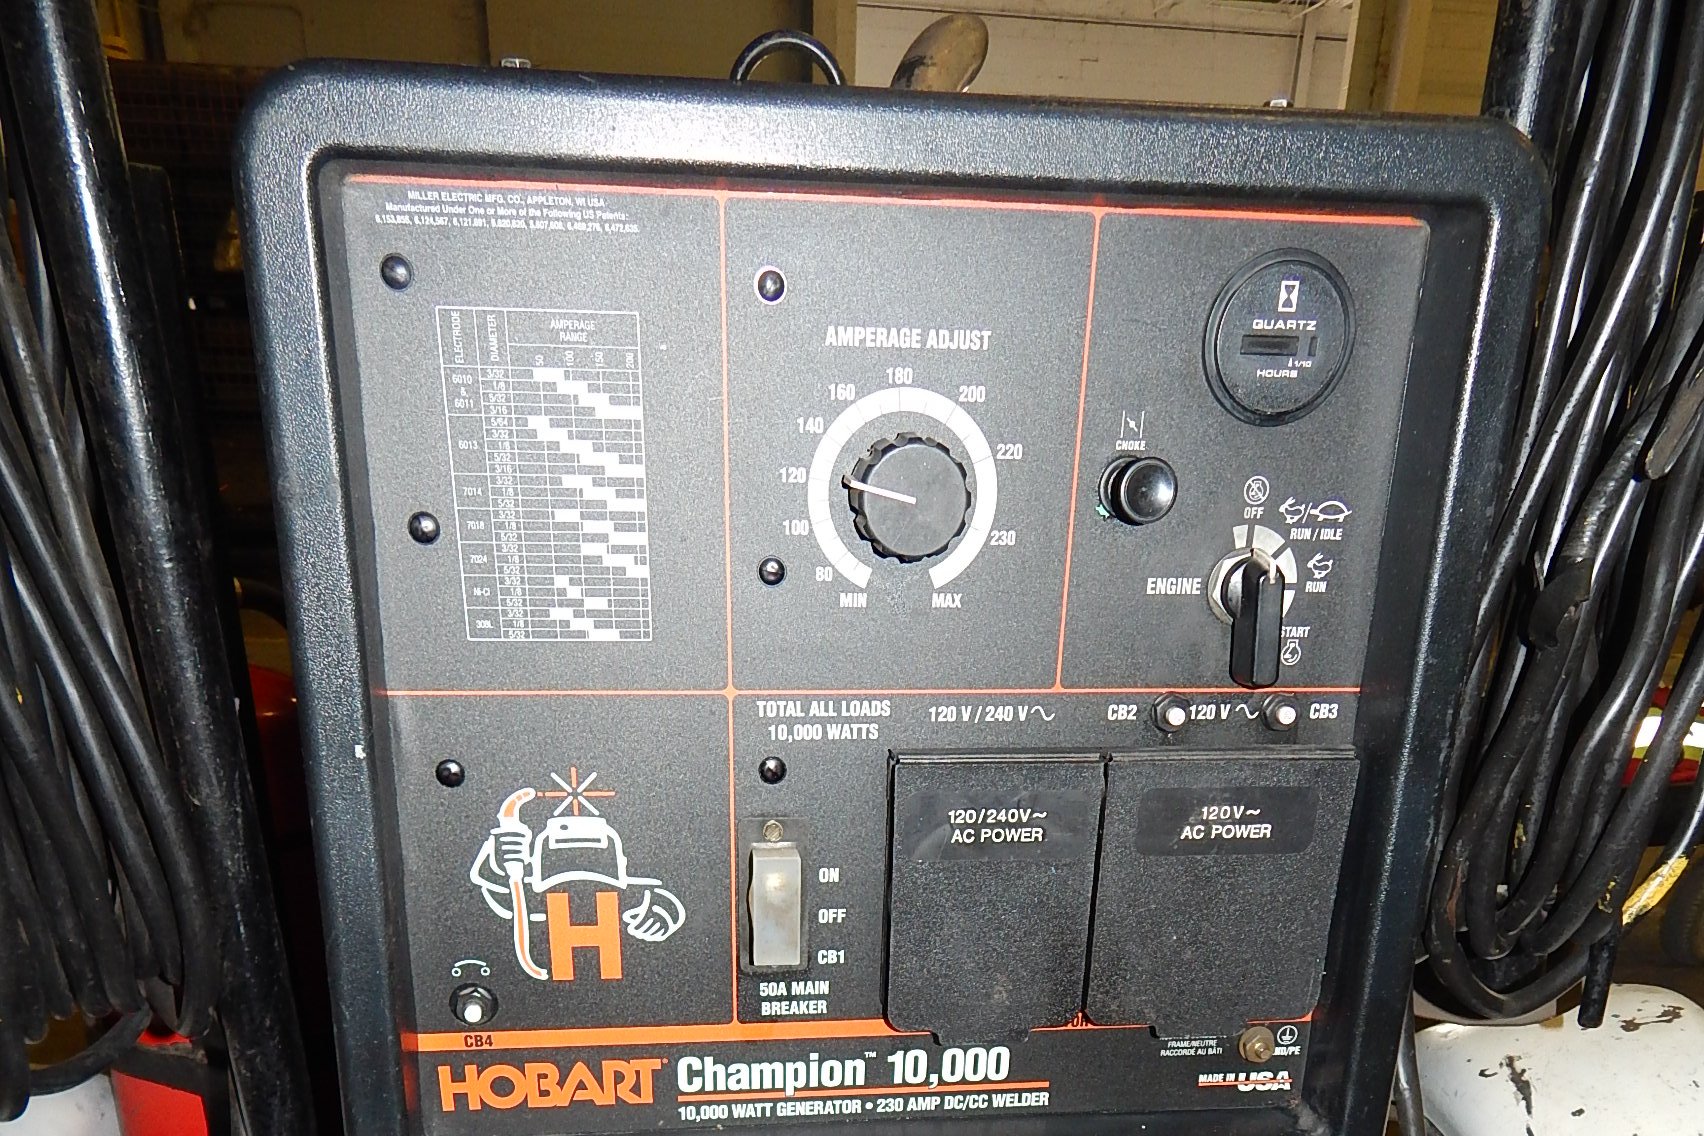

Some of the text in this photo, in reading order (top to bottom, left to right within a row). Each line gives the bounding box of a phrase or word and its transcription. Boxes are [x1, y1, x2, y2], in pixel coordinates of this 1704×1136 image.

[408, 190, 439, 200] MILLER
[440, 191, 482, 202] ELECTRIC
[575, 196, 586, 206] WI
[588, 197, 605, 207] USA
[385, 202, 440, 212] Manufactured
[442, 204, 466, 214] Under
[468, 206, 484, 215] One
[486, 207, 495, 215] or
[497, 206, 517, 216] More
[519, 207, 527, 216] of
[529, 207, 541, 216] the
[543, 208, 580, 220] Following
[583, 210, 594, 219] US
[551, 319, 596, 331] AMPERAGE
[1252, 319, 1317, 331] QUARTZ
[450, 310, 464, 364] ELECTRODE
[487, 314, 499, 361] DIAMETER
[560, 332, 588, 342] RANGE
[825, 326, 992, 350] AMPERAGE ADJUST
[535, 351, 635, 368] 50 100 150 200
[452, 375, 472, 384] 6010
[487, 369, 505, 378] 3/32
[885, 368, 913, 384] 180
[1256, 368, 1298, 378] HOURS
[493, 382, 505, 391] 1/8
[828, 384, 856, 401] 160
[489, 394, 506, 403] 5/32
[958, 385, 986, 402] 200
[455, 399, 474, 409] 6011
[490, 406, 507, 415] 3/16
[491, 417, 508, 427] 5/64
[796, 417, 824, 434] 140
[492, 430, 509, 439] 3/32
[459, 440, 478, 449] 6013
[499, 441, 510, 450] 1/8
[1115, 440, 1146, 451] CHOKE
[494, 453, 511, 461] 5/32
[996, 443, 1023, 460] 220
[495, 465, 512, 473] 3/16
[779, 467, 807, 484] 120
[496, 476, 513, 485] 3/32
[463, 487, 482, 496] 7014
[502, 488, 514, 496] 1/8
[498, 499, 514, 508] 5/32
[499, 511, 515, 519] 3/32
[1243, 507, 1264, 520] OFF
[467, 521, 484, 530] 7018
[505, 522, 516, 530] 1/8
[782, 519, 810, 536] 100
[501, 533, 517, 541] 5/32
[990, 530, 1016, 546] 230
[1290, 528, 1312, 541] RUN
[1320, 528, 1343, 541] IDLE
[502, 544, 518, 552] 3/32
[470, 555, 488, 563] 7024
[507, 555, 519, 563] 1/8
[504, 566, 520, 574] 5/32
[815, 566, 833, 582] 80
[505, 577, 520, 585] 3/32
[1146, 577, 1202, 595] ENGINE
[1305, 580, 1327, 593] RUN
[510, 588, 522, 596] 1/8
[506, 599, 523, 607] 5/32
[839, 593, 868, 608] MIN
[932, 593, 962, 608] MAX
[507, 609, 523, 617] 3/32
[513, 620, 525, 628] 1/8
[508, 631, 525, 639] 5/32
[756, 699, 891, 718] TOTAL ALL LOADS
[928, 706, 957, 722] 120
[962, 706, 973, 722] V
[985, 706, 1014, 722] 240
[1018, 706, 1029, 722] V
[1107, 704, 1137, 721] CB2
[1189, 703, 1231, 720] 120 V
[1309, 703, 1339, 720] CB3
[768, 723, 879, 742] 10,000 WATTS
[950, 827, 1043, 844] AC POWER
[1180, 823, 1272, 840] AC POWER
[818, 868, 840, 883] ON
[818, 908, 847, 924] OFF
[546, 891, 623, 981] H
[817, 949, 845, 964] CB1
[759, 980, 829, 997] 50A MAIN
[761, 1000, 827, 1015] BREAKER
[463, 1035, 493, 1048] CB4
[1167, 1039, 1218, 1048] FRAME/NEUTRE
[1160, 1047, 1195, 1056] RACCORDÉ
[887, 1046, 1010, 1089] 10,000
[437, 1058, 661, 1112] HOBART
[1198, 1073, 1224, 1083] MADE
[1237, 1070, 1291, 1092] USA
[678, 1092, 1050, 1122] 10,000 WATT GENERATOR 230 AMP DC/CC WELDER
